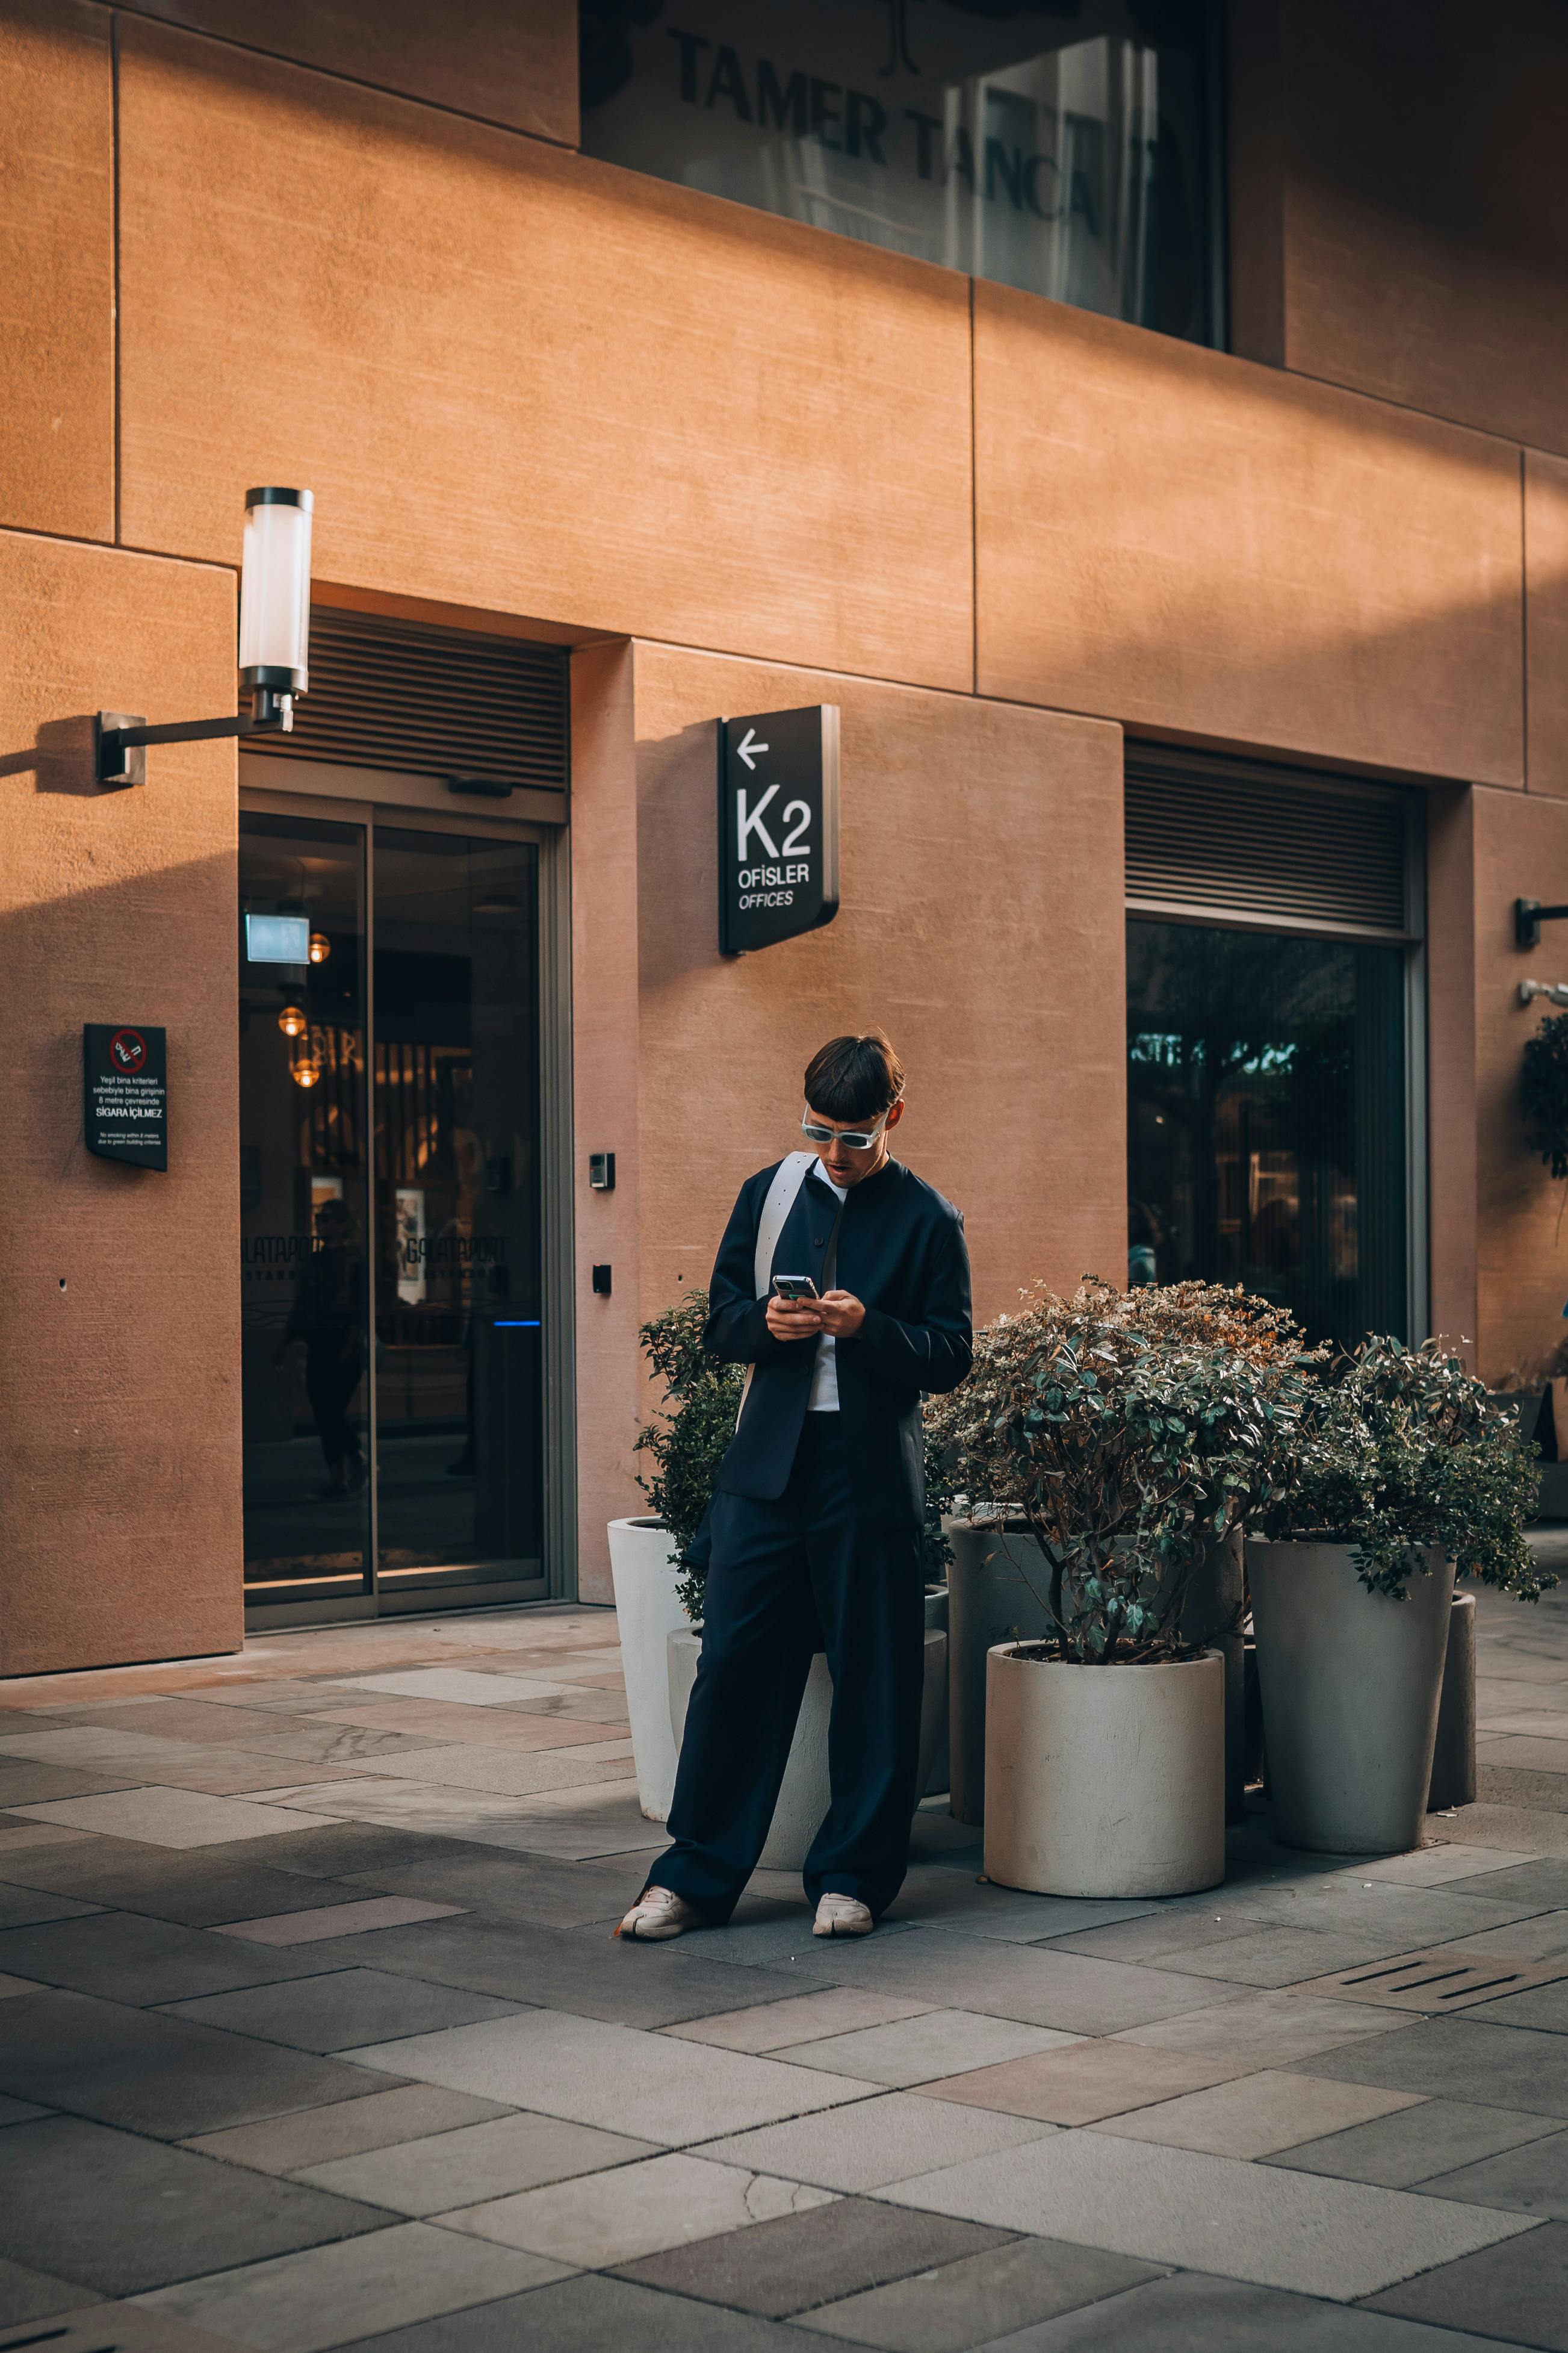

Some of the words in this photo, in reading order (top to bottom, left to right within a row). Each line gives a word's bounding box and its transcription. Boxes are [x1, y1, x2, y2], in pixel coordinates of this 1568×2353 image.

[665, 26, 888, 167] TAMER
[903, 107, 1101, 237] TANCA
[737, 784, 811, 862] K2
[738, 863, 810, 889] OFİSLER
[739, 891, 794, 910] OFFICES
[100, 1075, 116, 1085] Yeşil
[117, 1076, 131, 1084] bina
[93, 1086, 124, 1095] sebebiyle
[140, 1087, 165, 1096] girişinin
[99, 1096, 104, 1104] 8
[125, 1098, 160, 1107] çevresinde
[96, 1106, 128, 1117] SİGARA
[129, 1107, 163, 1120] İÇİLMEZ
